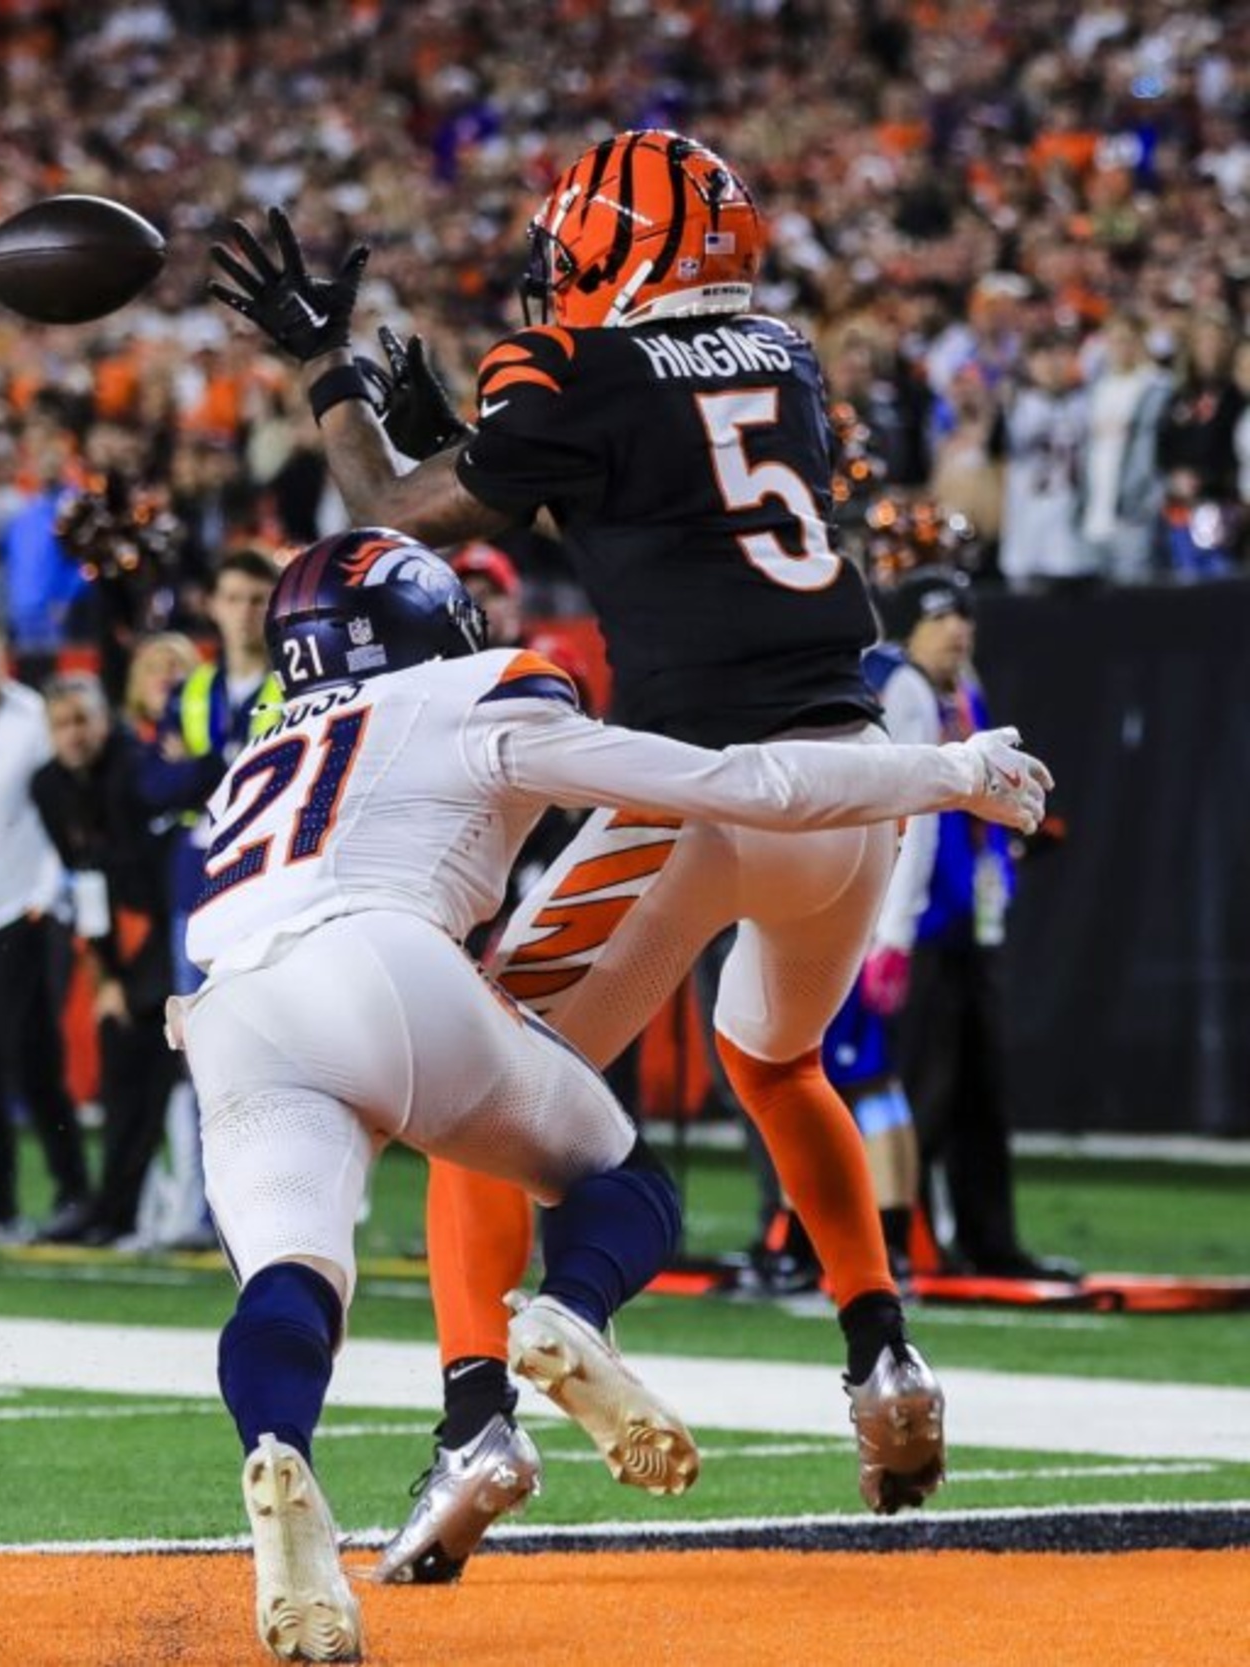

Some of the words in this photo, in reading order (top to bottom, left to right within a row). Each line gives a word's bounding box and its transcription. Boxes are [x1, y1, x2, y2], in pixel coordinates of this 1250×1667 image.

[631, 326, 793, 379] HIGGINS
[694, 387, 842, 592] 5
[283, 635, 325, 681] 21
[188, 703, 372, 913] 21
